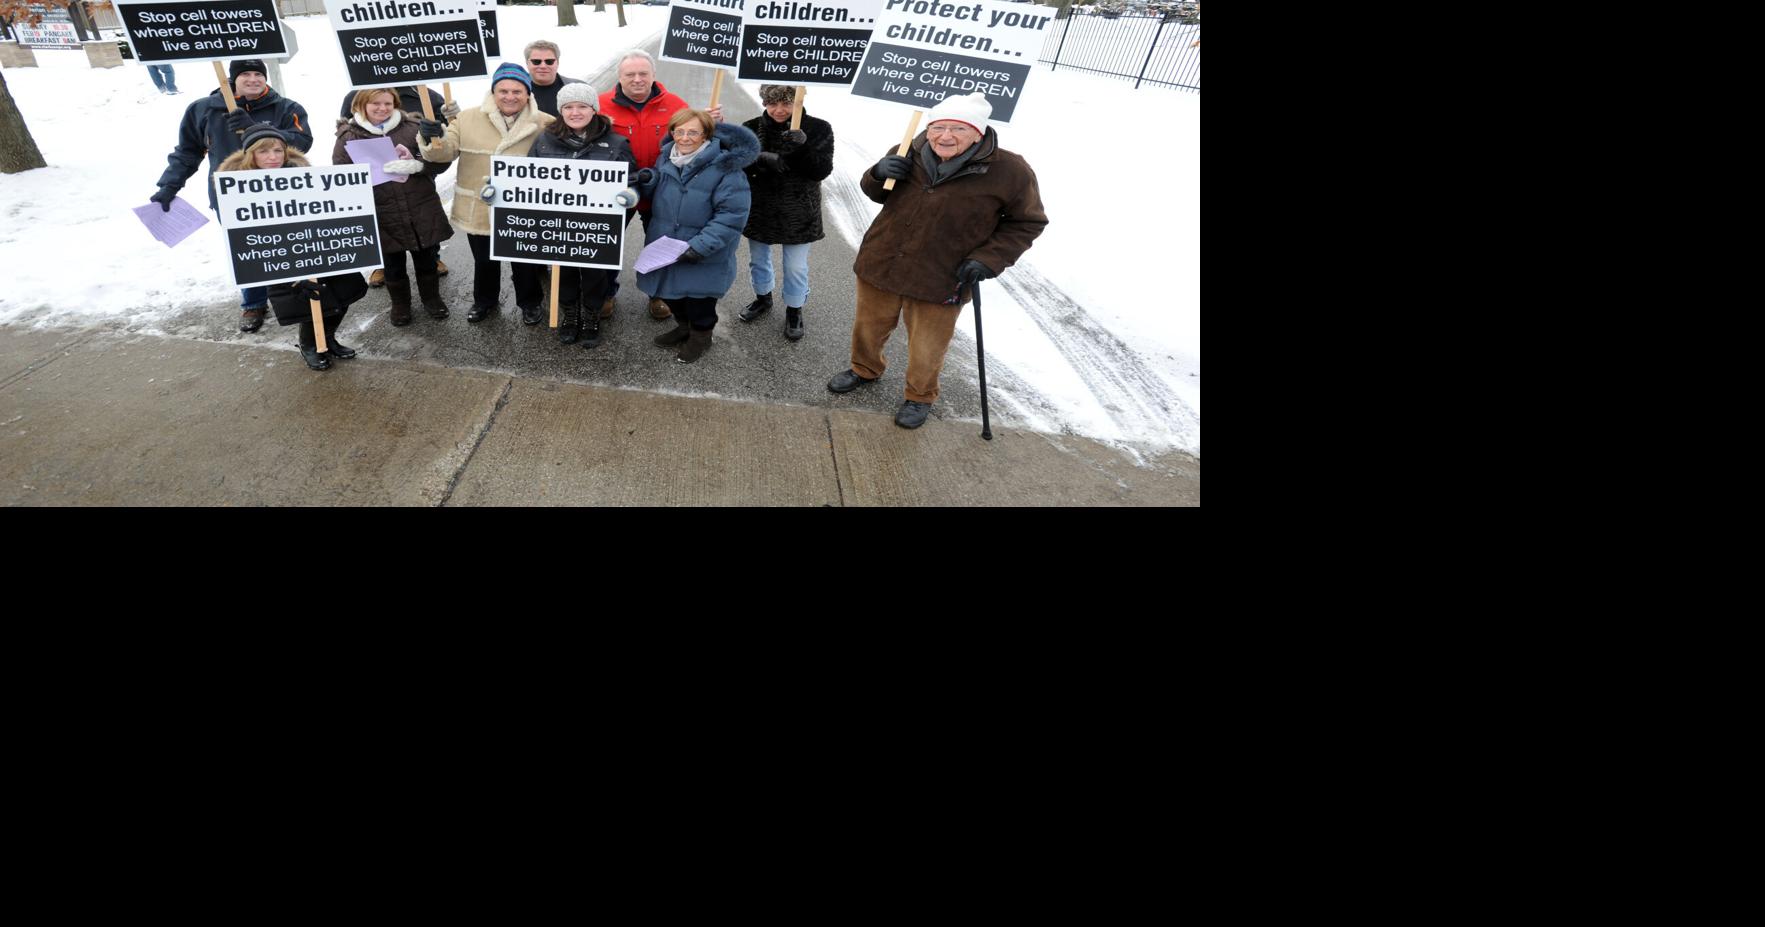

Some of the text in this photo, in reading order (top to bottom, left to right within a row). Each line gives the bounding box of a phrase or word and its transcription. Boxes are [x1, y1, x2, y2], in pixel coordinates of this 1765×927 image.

[138, 9, 262, 24] Stop cell towers
[755, 1, 874, 23] children...
[987, 10, 1051, 30] your
[134, 21, 275, 38] where CHILDREN
[682, 15, 709, 30] Stop
[713, 22, 734, 32] cell
[162, 38, 258, 51] live and play
[355, 30, 467, 49] Stop cell towers
[672, 29, 709, 41] where
[757, 33, 867, 48] Stop cell towers
[886, 23, 1022, 57] children...
[350, 42, 479, 63] where CHILDREN
[686, 42, 733, 58] live and
[746, 48, 862, 62] where CHILDRE
[373, 59, 461, 75] live and play
[764, 62, 851, 77] live and play
[881, 52, 1010, 81] Stop cell towers
[867, 65, 1016, 98] where CHILDREN
[882, 81, 946, 101] live and
[494, 161, 626, 184] Protect your
[219, 171, 368, 195] Protect your
[503, 187, 613, 208] children...
[236, 200, 362, 221] children...
[507, 215, 610, 231] Stop cell towers
[246, 225, 364, 245] Stop cell towers
[498, 228, 617, 244] where CHILDREN
[238, 235, 374, 261] where CHILDREN
[516, 241, 598, 258] live and play
[264, 252, 357, 272] live and play
